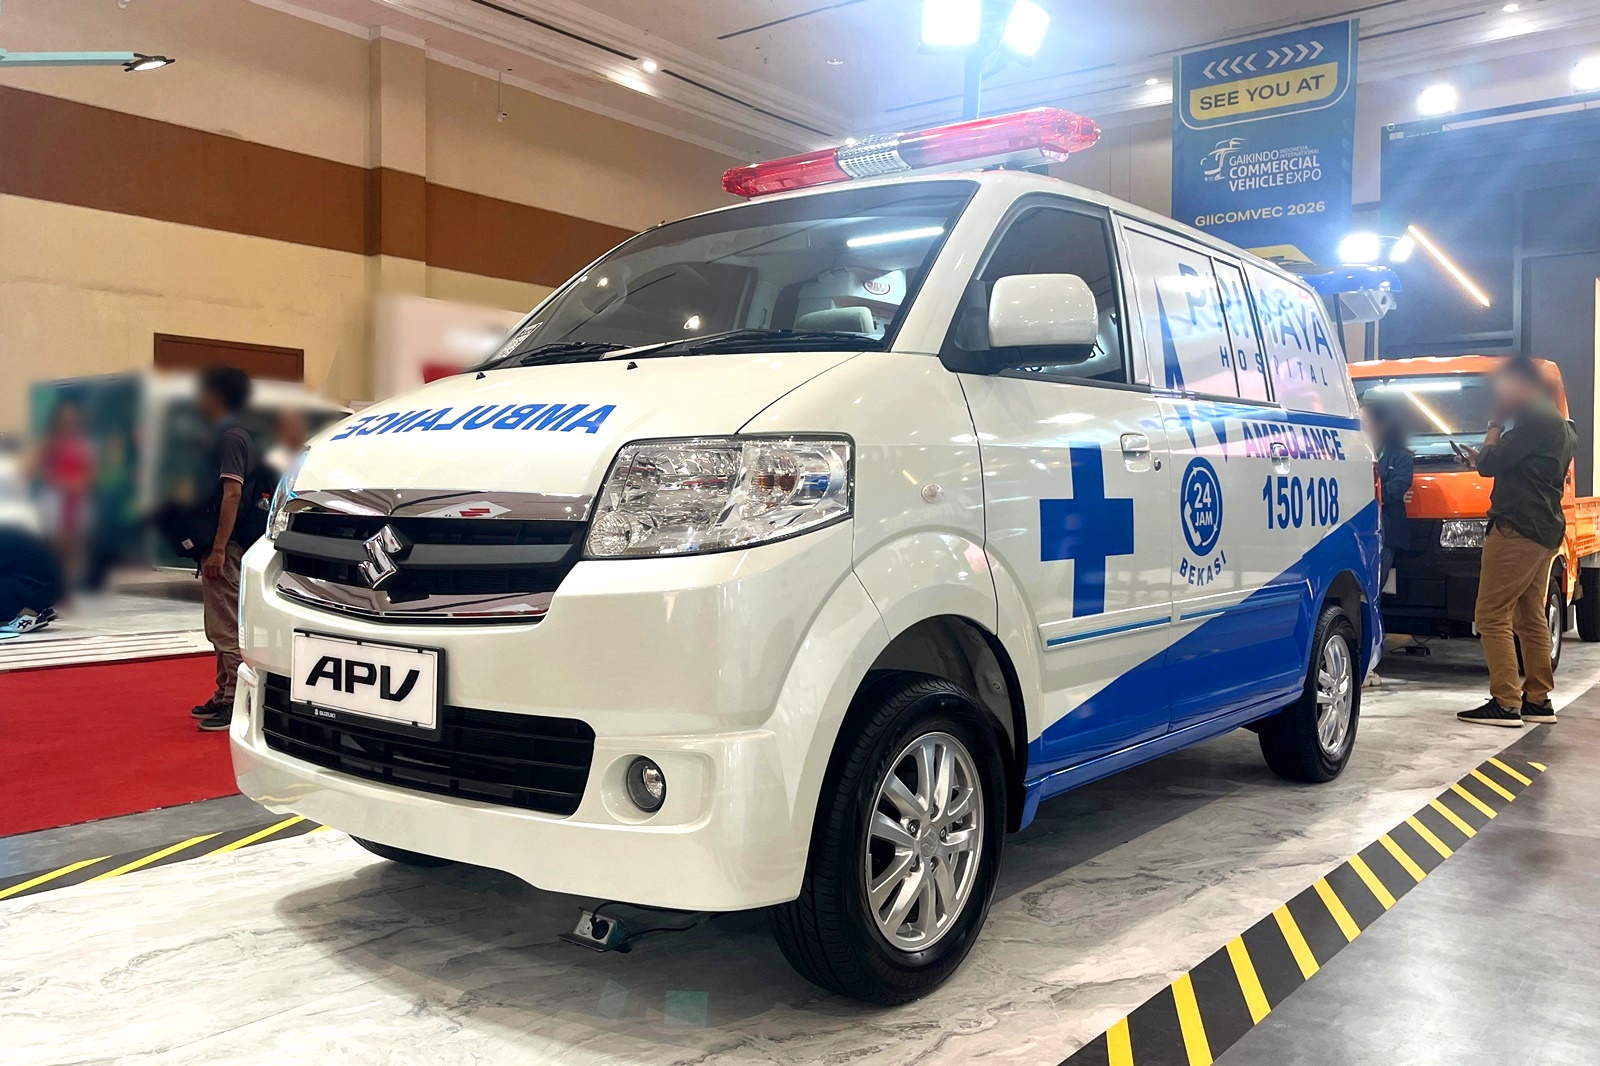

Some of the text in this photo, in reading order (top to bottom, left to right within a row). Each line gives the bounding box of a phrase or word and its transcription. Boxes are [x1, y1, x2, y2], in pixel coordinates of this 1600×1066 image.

[1200, 74, 1325, 110] SEE YOU AT
[1229, 150, 1279, 166] GAIKINDO
[1280, 145, 1308, 154] INDONESIA
[1280, 149, 1320, 159] INTERNATIONAL
[1229, 155, 1320, 179] COMMERCIAL
[1229, 168, 1322, 192] VEHICLE EXPO
[1195, 201, 1326, 226] GIICOMVEC 2026
[1219, 345, 1328, 386] HOSPITAL
[1242, 421, 1346, 461] AMBULANCE
[1194, 483, 1211, 508] 24
[1195, 512, 1213, 526] JAM
[1179, 550, 1227, 587] BEKASI
[305, 655, 420, 702] APV
